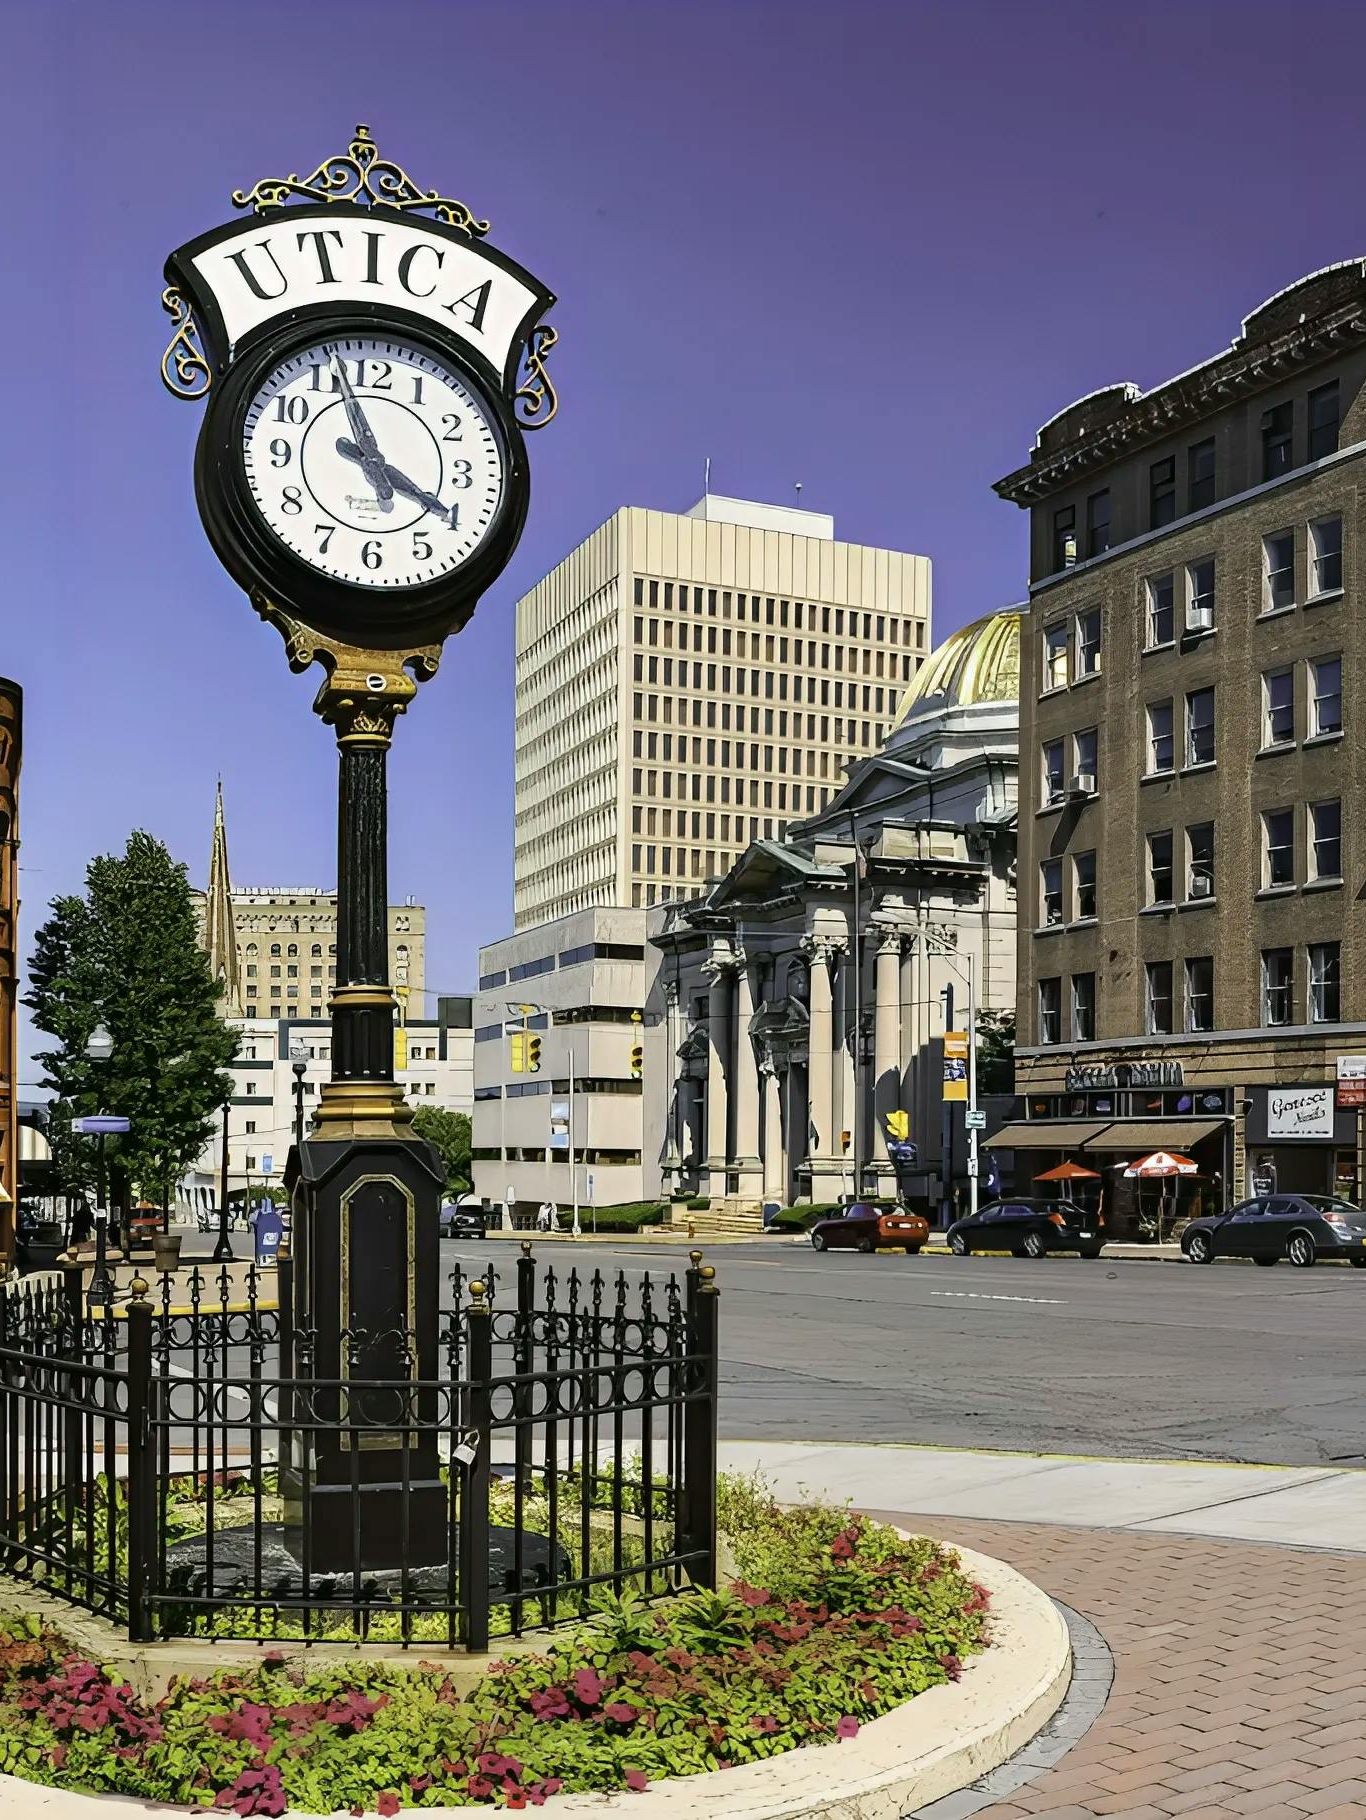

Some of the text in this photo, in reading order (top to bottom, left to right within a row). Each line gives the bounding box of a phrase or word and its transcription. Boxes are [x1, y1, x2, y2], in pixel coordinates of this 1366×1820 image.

[224, 231, 493, 334] UTICA
[352, 359, 392, 390] 12
[409, 376, 426, 405] 1
[271, 395, 309, 425] 10
[441, 413, 463, 442] 2
[269, 438, 292, 468] 9
[451, 459, 473, 489] 3
[280, 485, 303, 516] 8
[314, 524, 336, 555] 7
[412, 531, 433, 560] 5
[361, 540, 383, 570] 6
